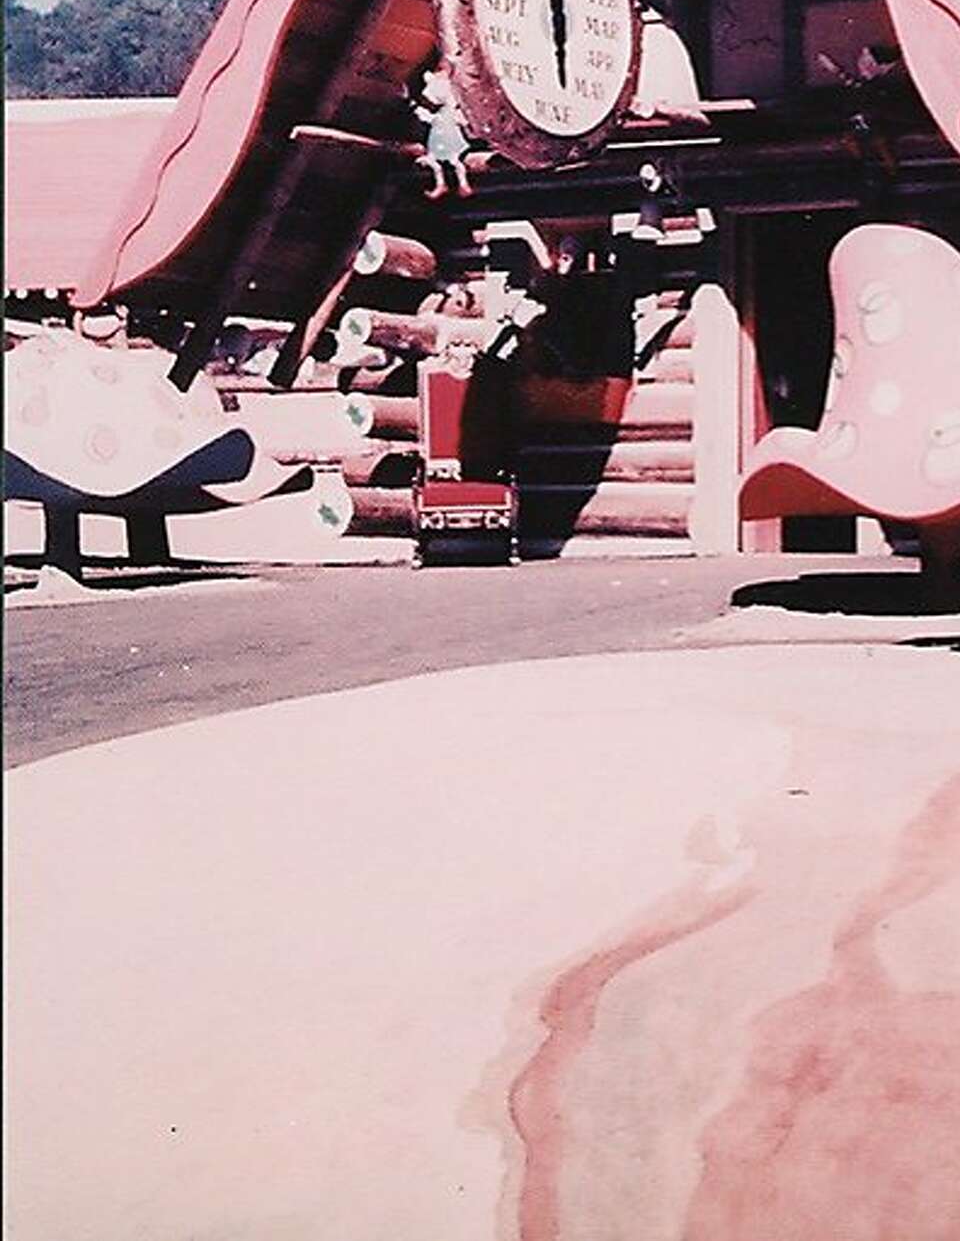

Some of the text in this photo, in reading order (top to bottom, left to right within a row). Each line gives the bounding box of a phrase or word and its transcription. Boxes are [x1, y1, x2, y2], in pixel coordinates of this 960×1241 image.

[484, 25, 520, 47] AUG
[584, 16, 619, 40] MAR
[586, 50, 614, 72] APR
[574, 77, 604, 101] MAY
[535, 98, 572, 124] JUNE
